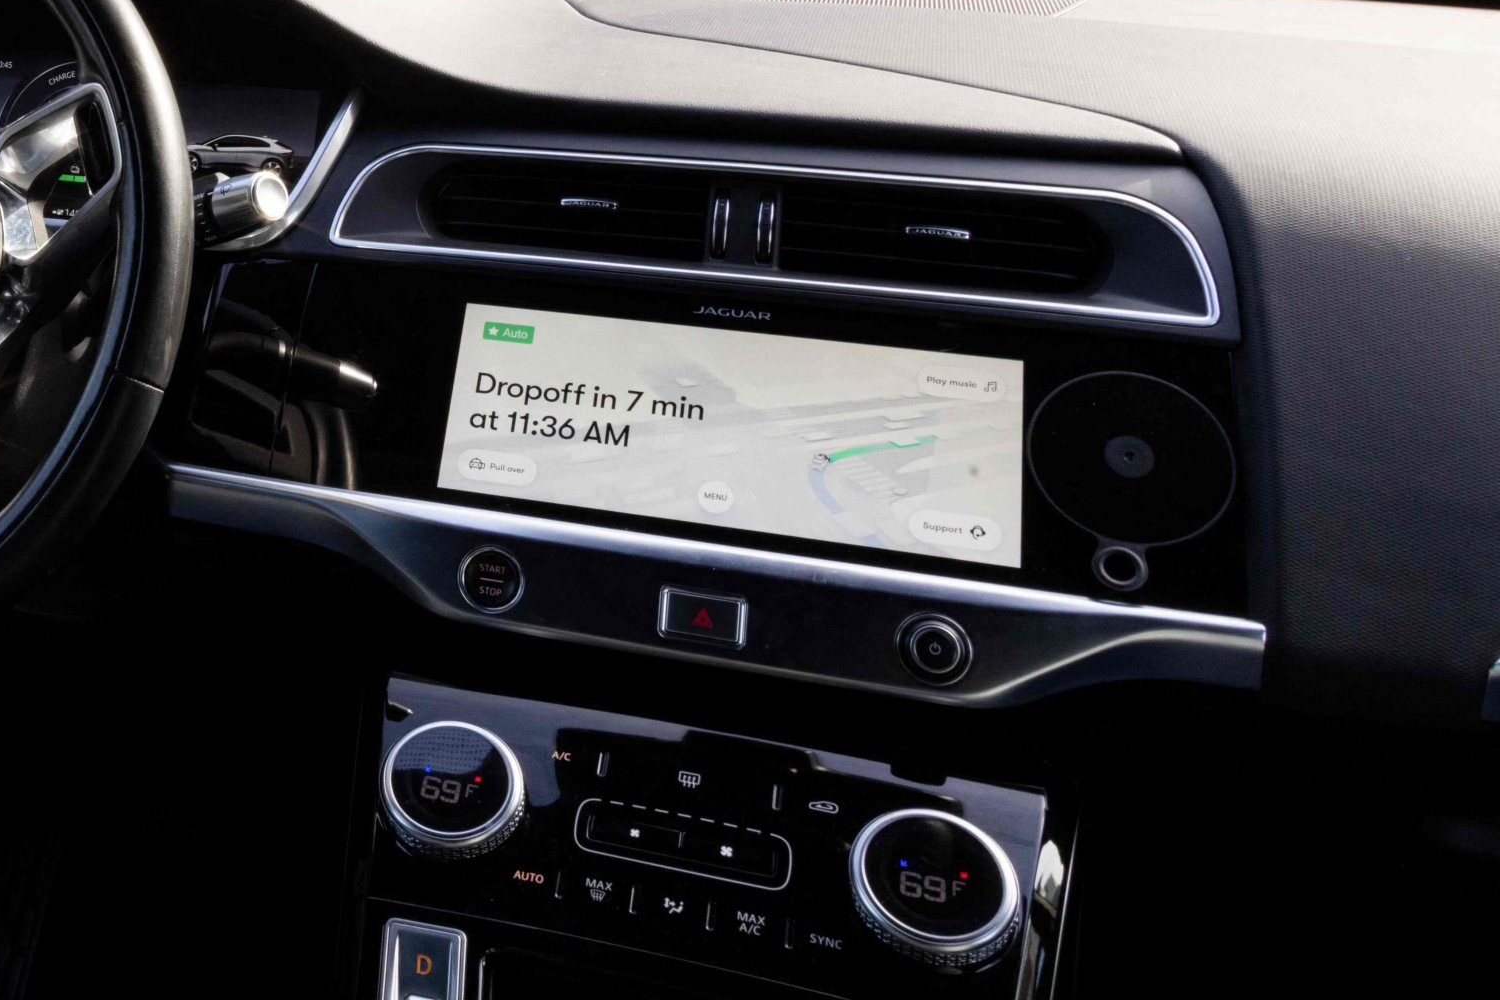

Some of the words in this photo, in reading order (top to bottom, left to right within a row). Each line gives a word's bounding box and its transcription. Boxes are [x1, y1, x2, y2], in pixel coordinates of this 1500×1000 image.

[48, 70, 76, 86] CHARGE
[693, 305, 771, 320] JAGUAR
[502, 327, 528, 340] Auto
[926, 376, 947, 387] Play
[949, 379, 978, 389] music
[475, 372, 586, 405] Dropoff
[592, 386, 617, 410] in
[626, 390, 644, 412] 7
[651, 396, 704, 421] min
[469, 410, 499, 431] at
[507, 411, 576, 440] 11:36
[582, 421, 631, 447] AM
[489, 462, 505, 471] Pull
[506, 466, 525, 474] over
[703, 491, 728, 503] MENU
[923, 521, 963, 535] Support
[479, 563, 506, 574] START
[479, 585, 502, 597] STOP
[551, 749, 572, 762] A/C
[419, 774, 462, 804] 69
[513, 869, 545, 884] AUTO
[585, 876, 613, 892] MAX
[898, 870, 947, 904] 69
[736, 909, 766, 927] MAX
[739, 922, 762, 937] A/C
[809, 932, 843, 951] SYNC
[415, 953, 433, 976] D
